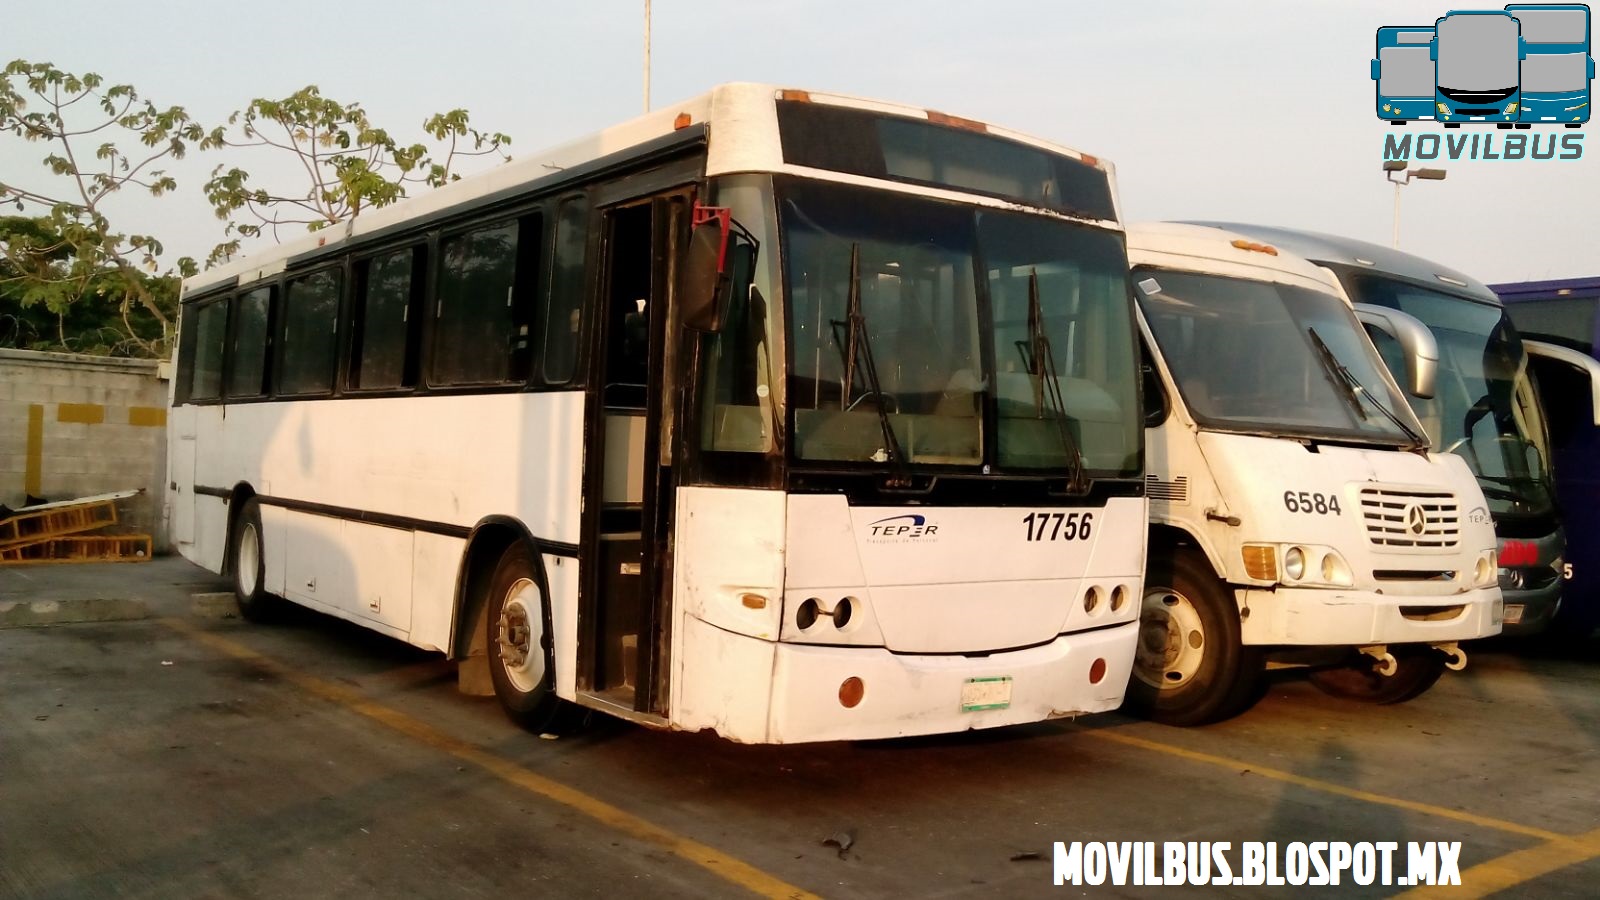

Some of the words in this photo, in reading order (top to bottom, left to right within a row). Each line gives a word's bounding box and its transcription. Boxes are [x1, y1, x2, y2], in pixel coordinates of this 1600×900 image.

[1284, 490, 1341, 516] 6584
[871, 525, 939, 538] TEPER
[1023, 512, 1093, 541] 17756
